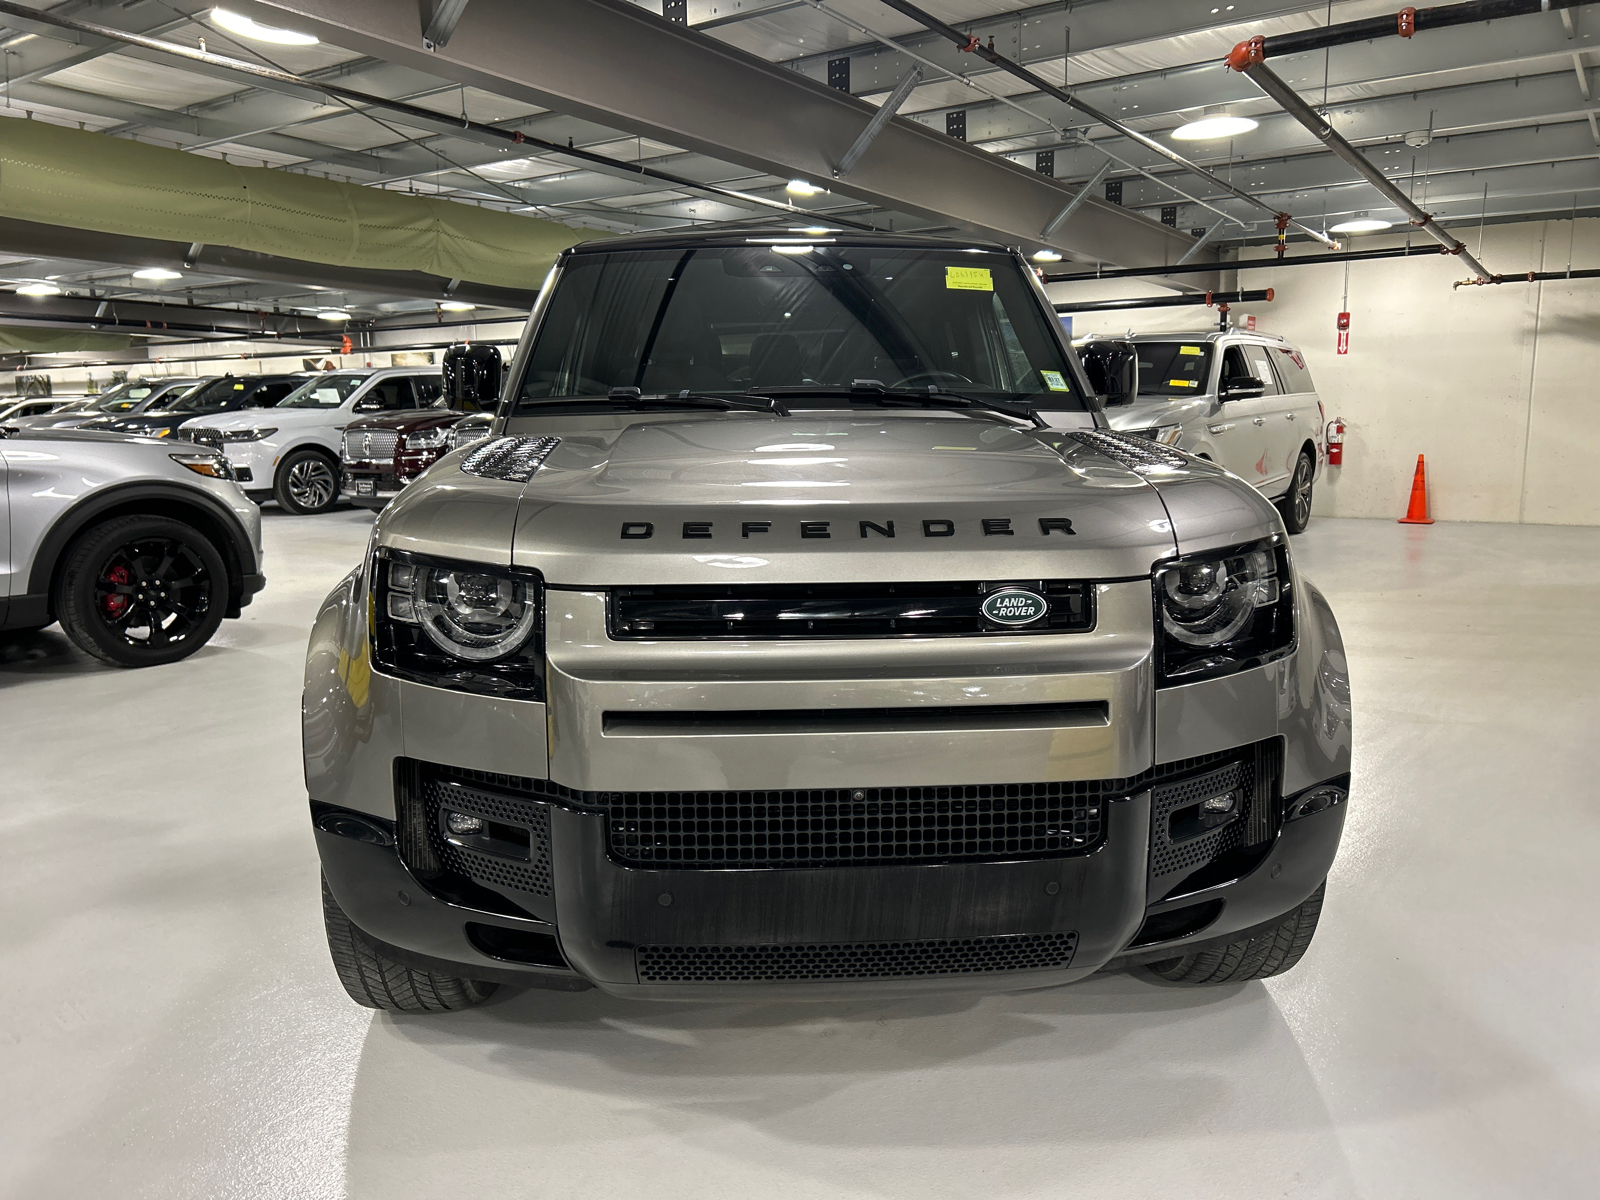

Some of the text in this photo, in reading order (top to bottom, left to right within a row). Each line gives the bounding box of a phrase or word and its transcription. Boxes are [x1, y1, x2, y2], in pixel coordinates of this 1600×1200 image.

[619, 517, 1078, 540] DEFENDER
[996, 597, 1026, 607] LAND
[998, 606, 1035, 617] ROVER
